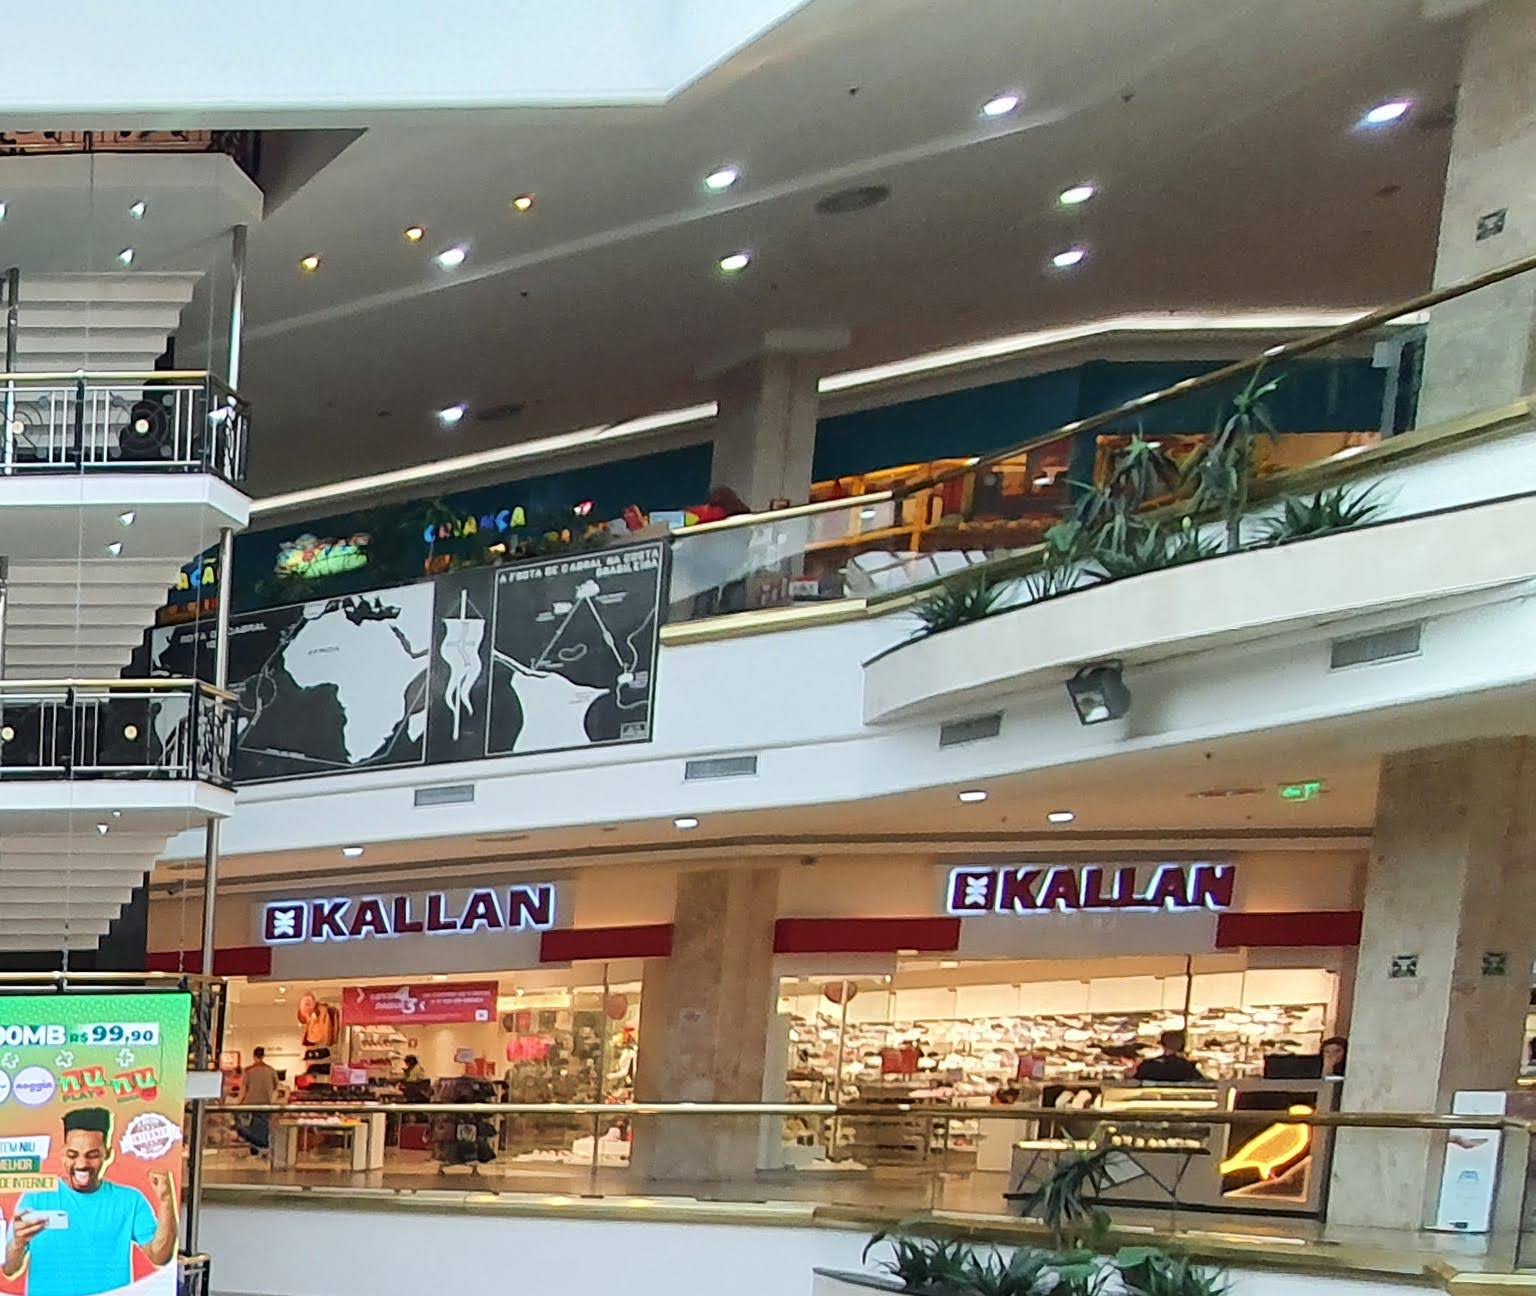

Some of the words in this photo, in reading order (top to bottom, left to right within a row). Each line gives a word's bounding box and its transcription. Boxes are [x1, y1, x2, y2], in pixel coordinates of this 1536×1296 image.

[310, 883, 556, 940] KALLAN
[995, 864, 1236, 913] KALLAN
[92, 1026, 153, 1043] 99,90
